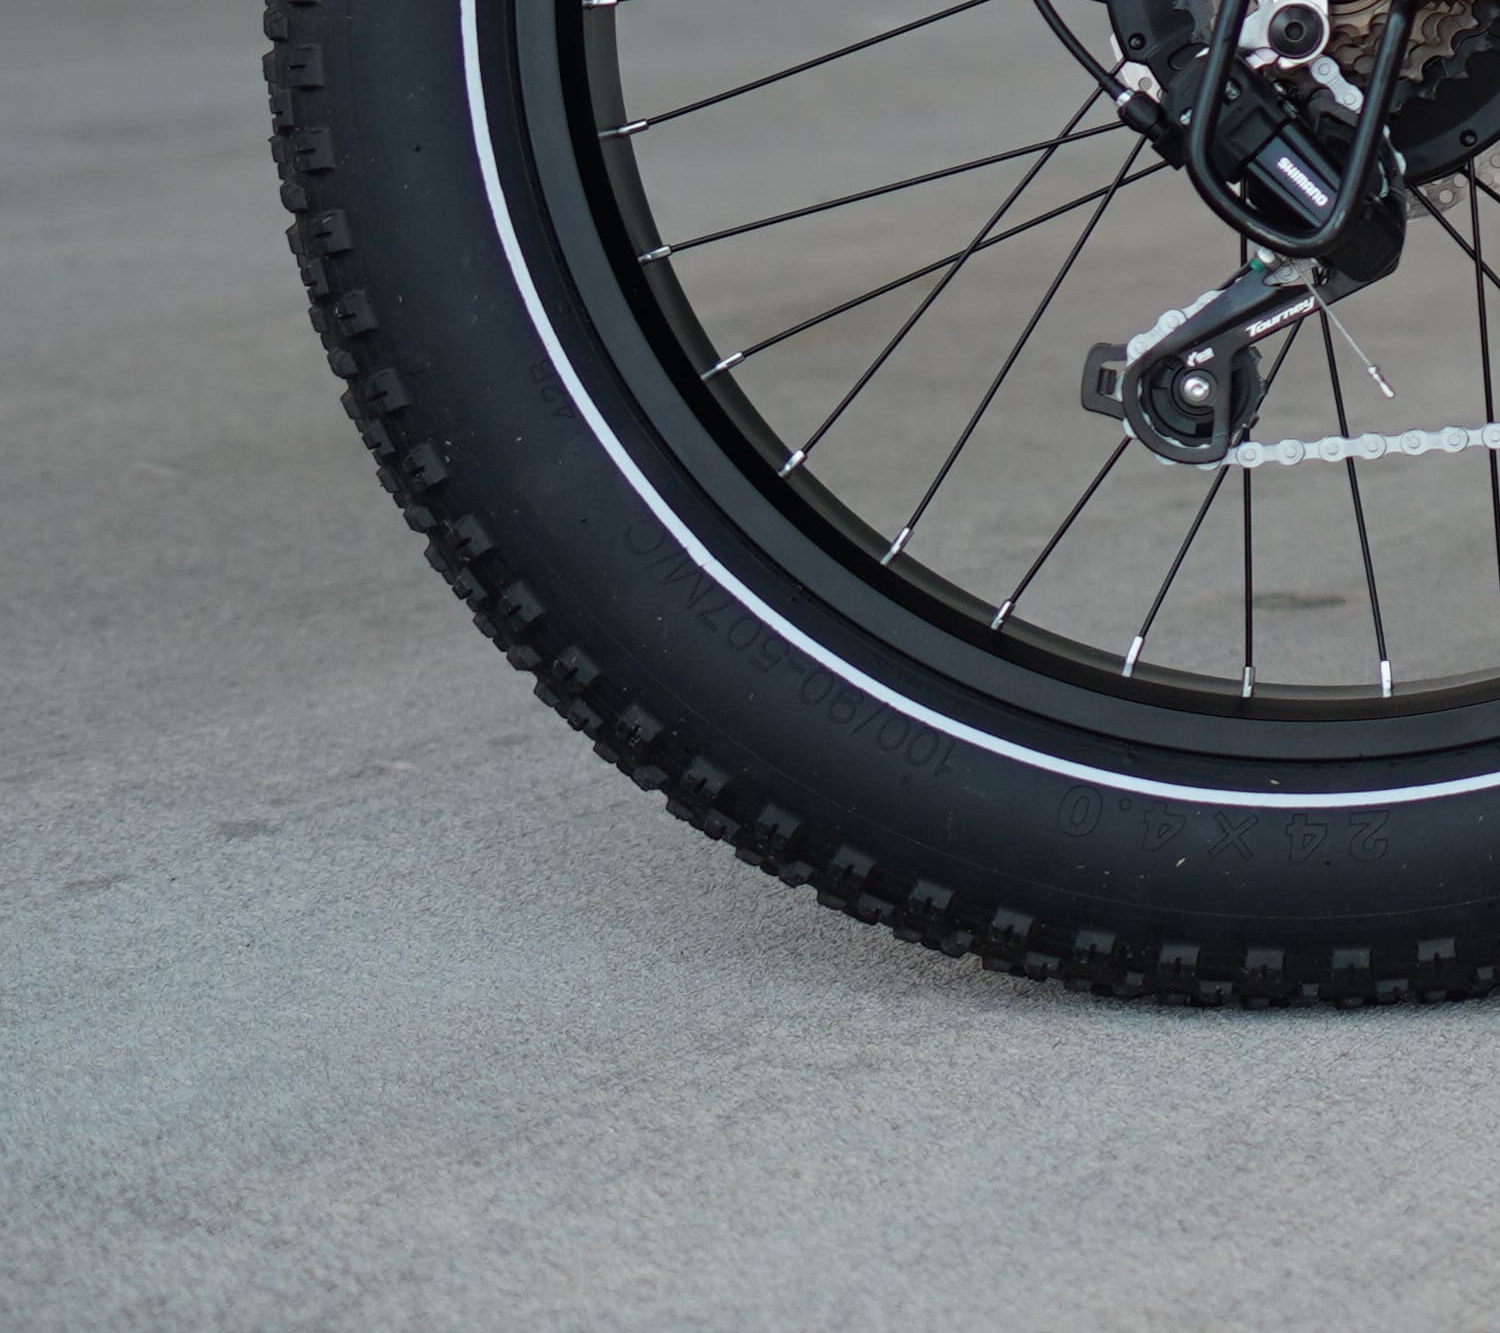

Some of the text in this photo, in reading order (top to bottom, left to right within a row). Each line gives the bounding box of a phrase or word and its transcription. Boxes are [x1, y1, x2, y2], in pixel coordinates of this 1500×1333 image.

[1276, 156, 1329, 207] SHIMANO
[1245, 295, 1316, 337] Tourney
[1284, 809, 1391, 865] 24
